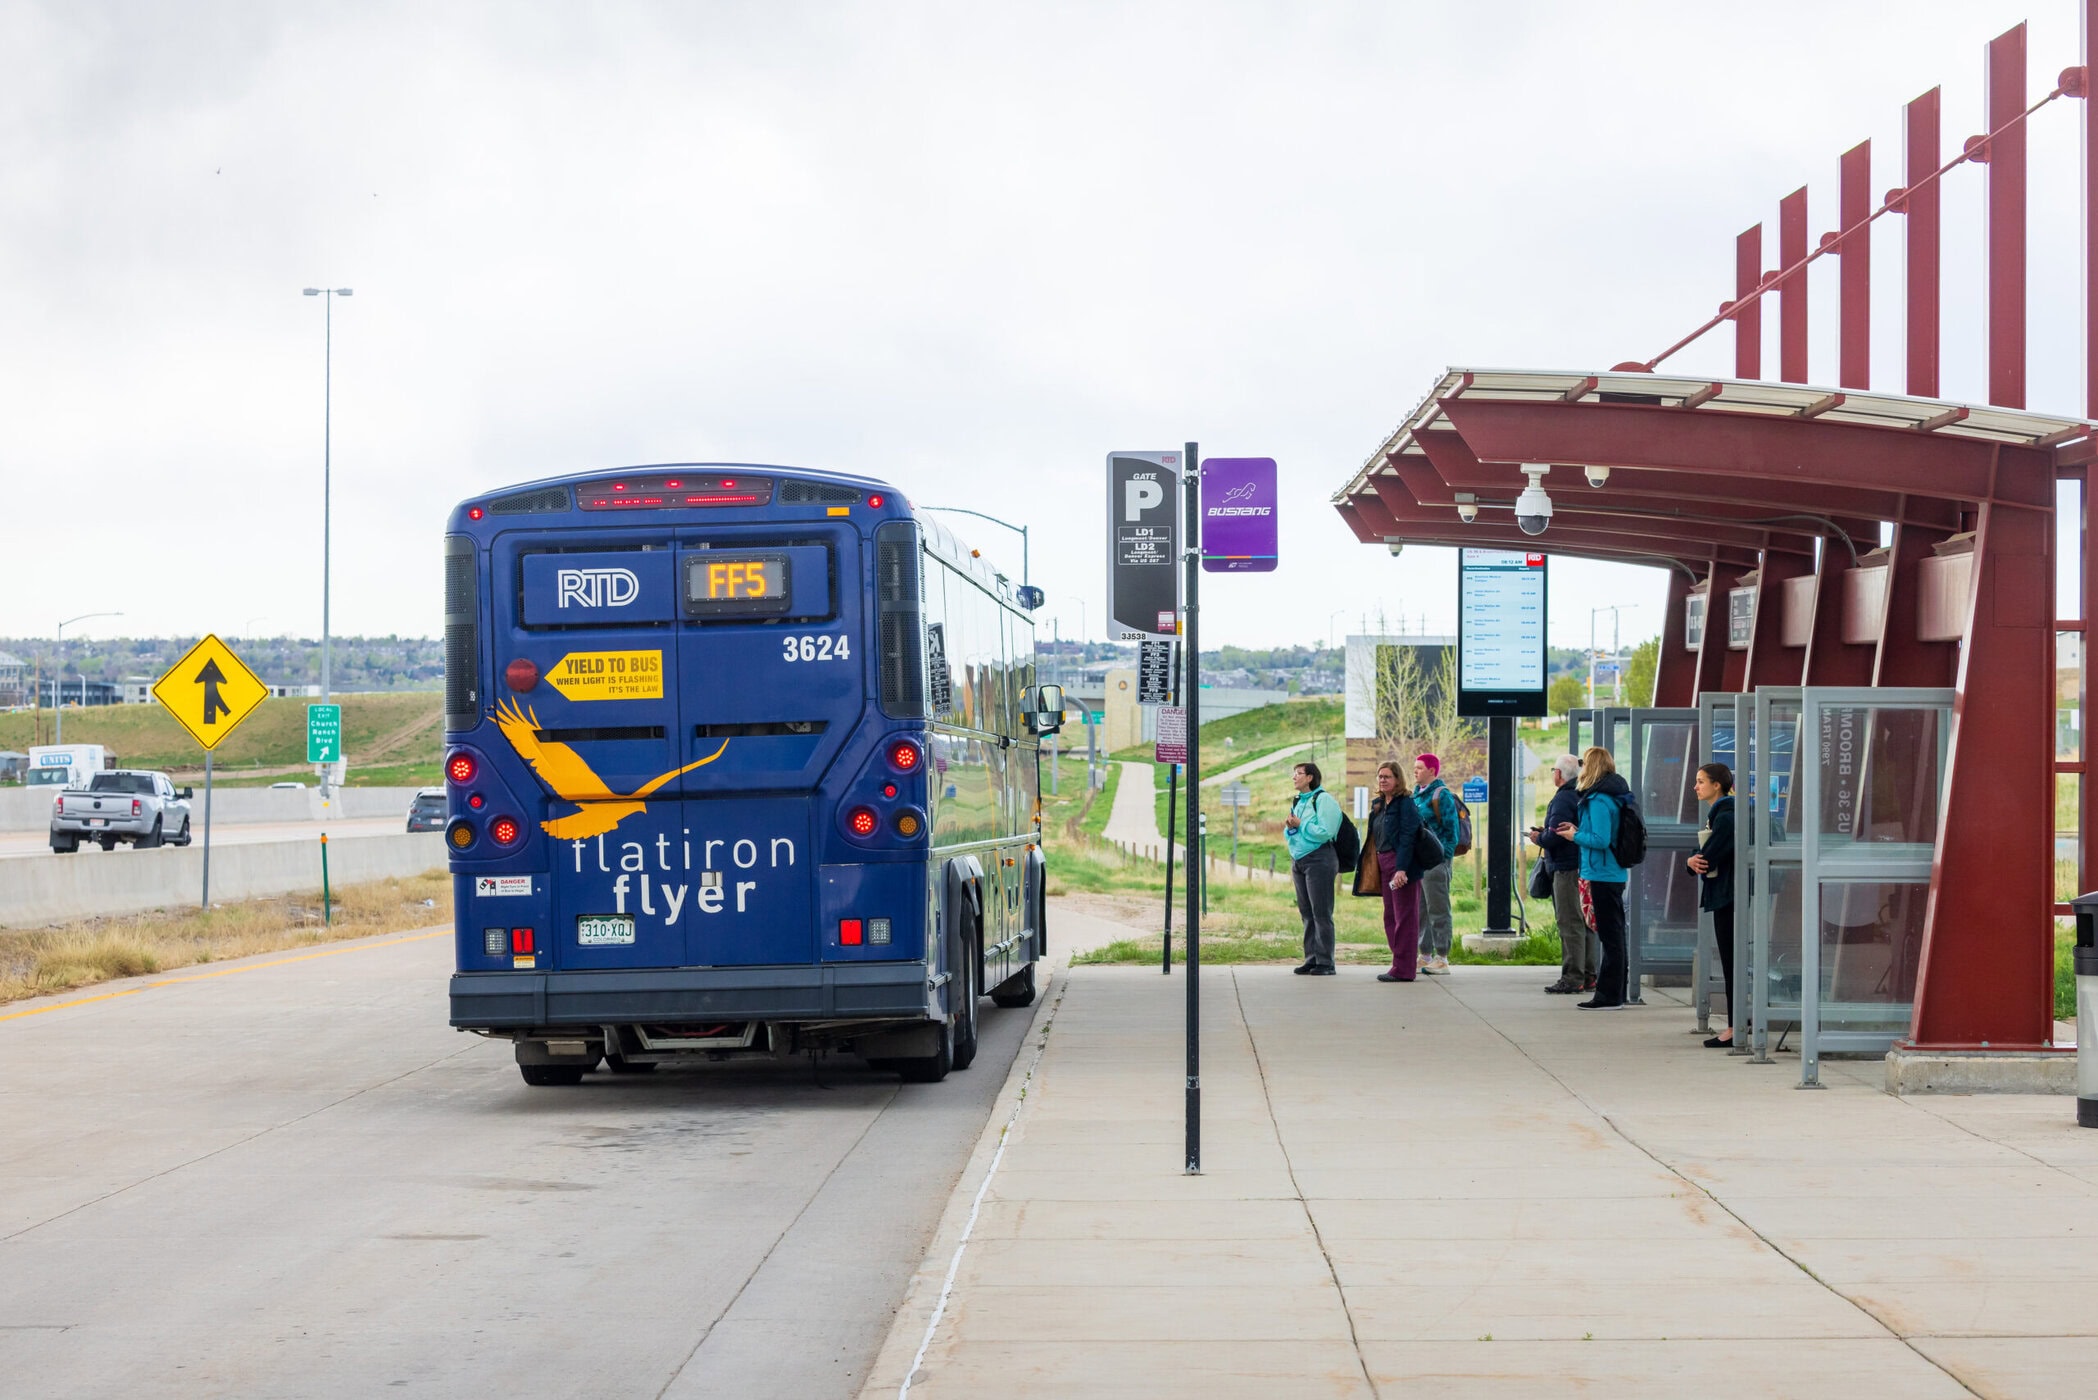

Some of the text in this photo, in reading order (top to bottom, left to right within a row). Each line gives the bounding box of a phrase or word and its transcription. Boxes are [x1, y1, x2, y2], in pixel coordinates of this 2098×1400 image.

[1132, 472, 1157, 480] GATE
[1125, 480, 1163, 521] P
[1207, 506, 1271, 516] BUSTANG
[1135, 528, 1153, 536] LD1
[558, 567, 640, 608] RTD
[708, 561, 767, 598] FF5
[782, 634, 850, 662] 3624
[564, 656, 658, 674] YIELD TO BUS
[556, 675, 659, 686] WHEN LIGHT IS FLASHING
[625, 685, 639, 693] THE
[572, 828, 795, 873] flatiron
[613, 874, 756, 926] flyer
